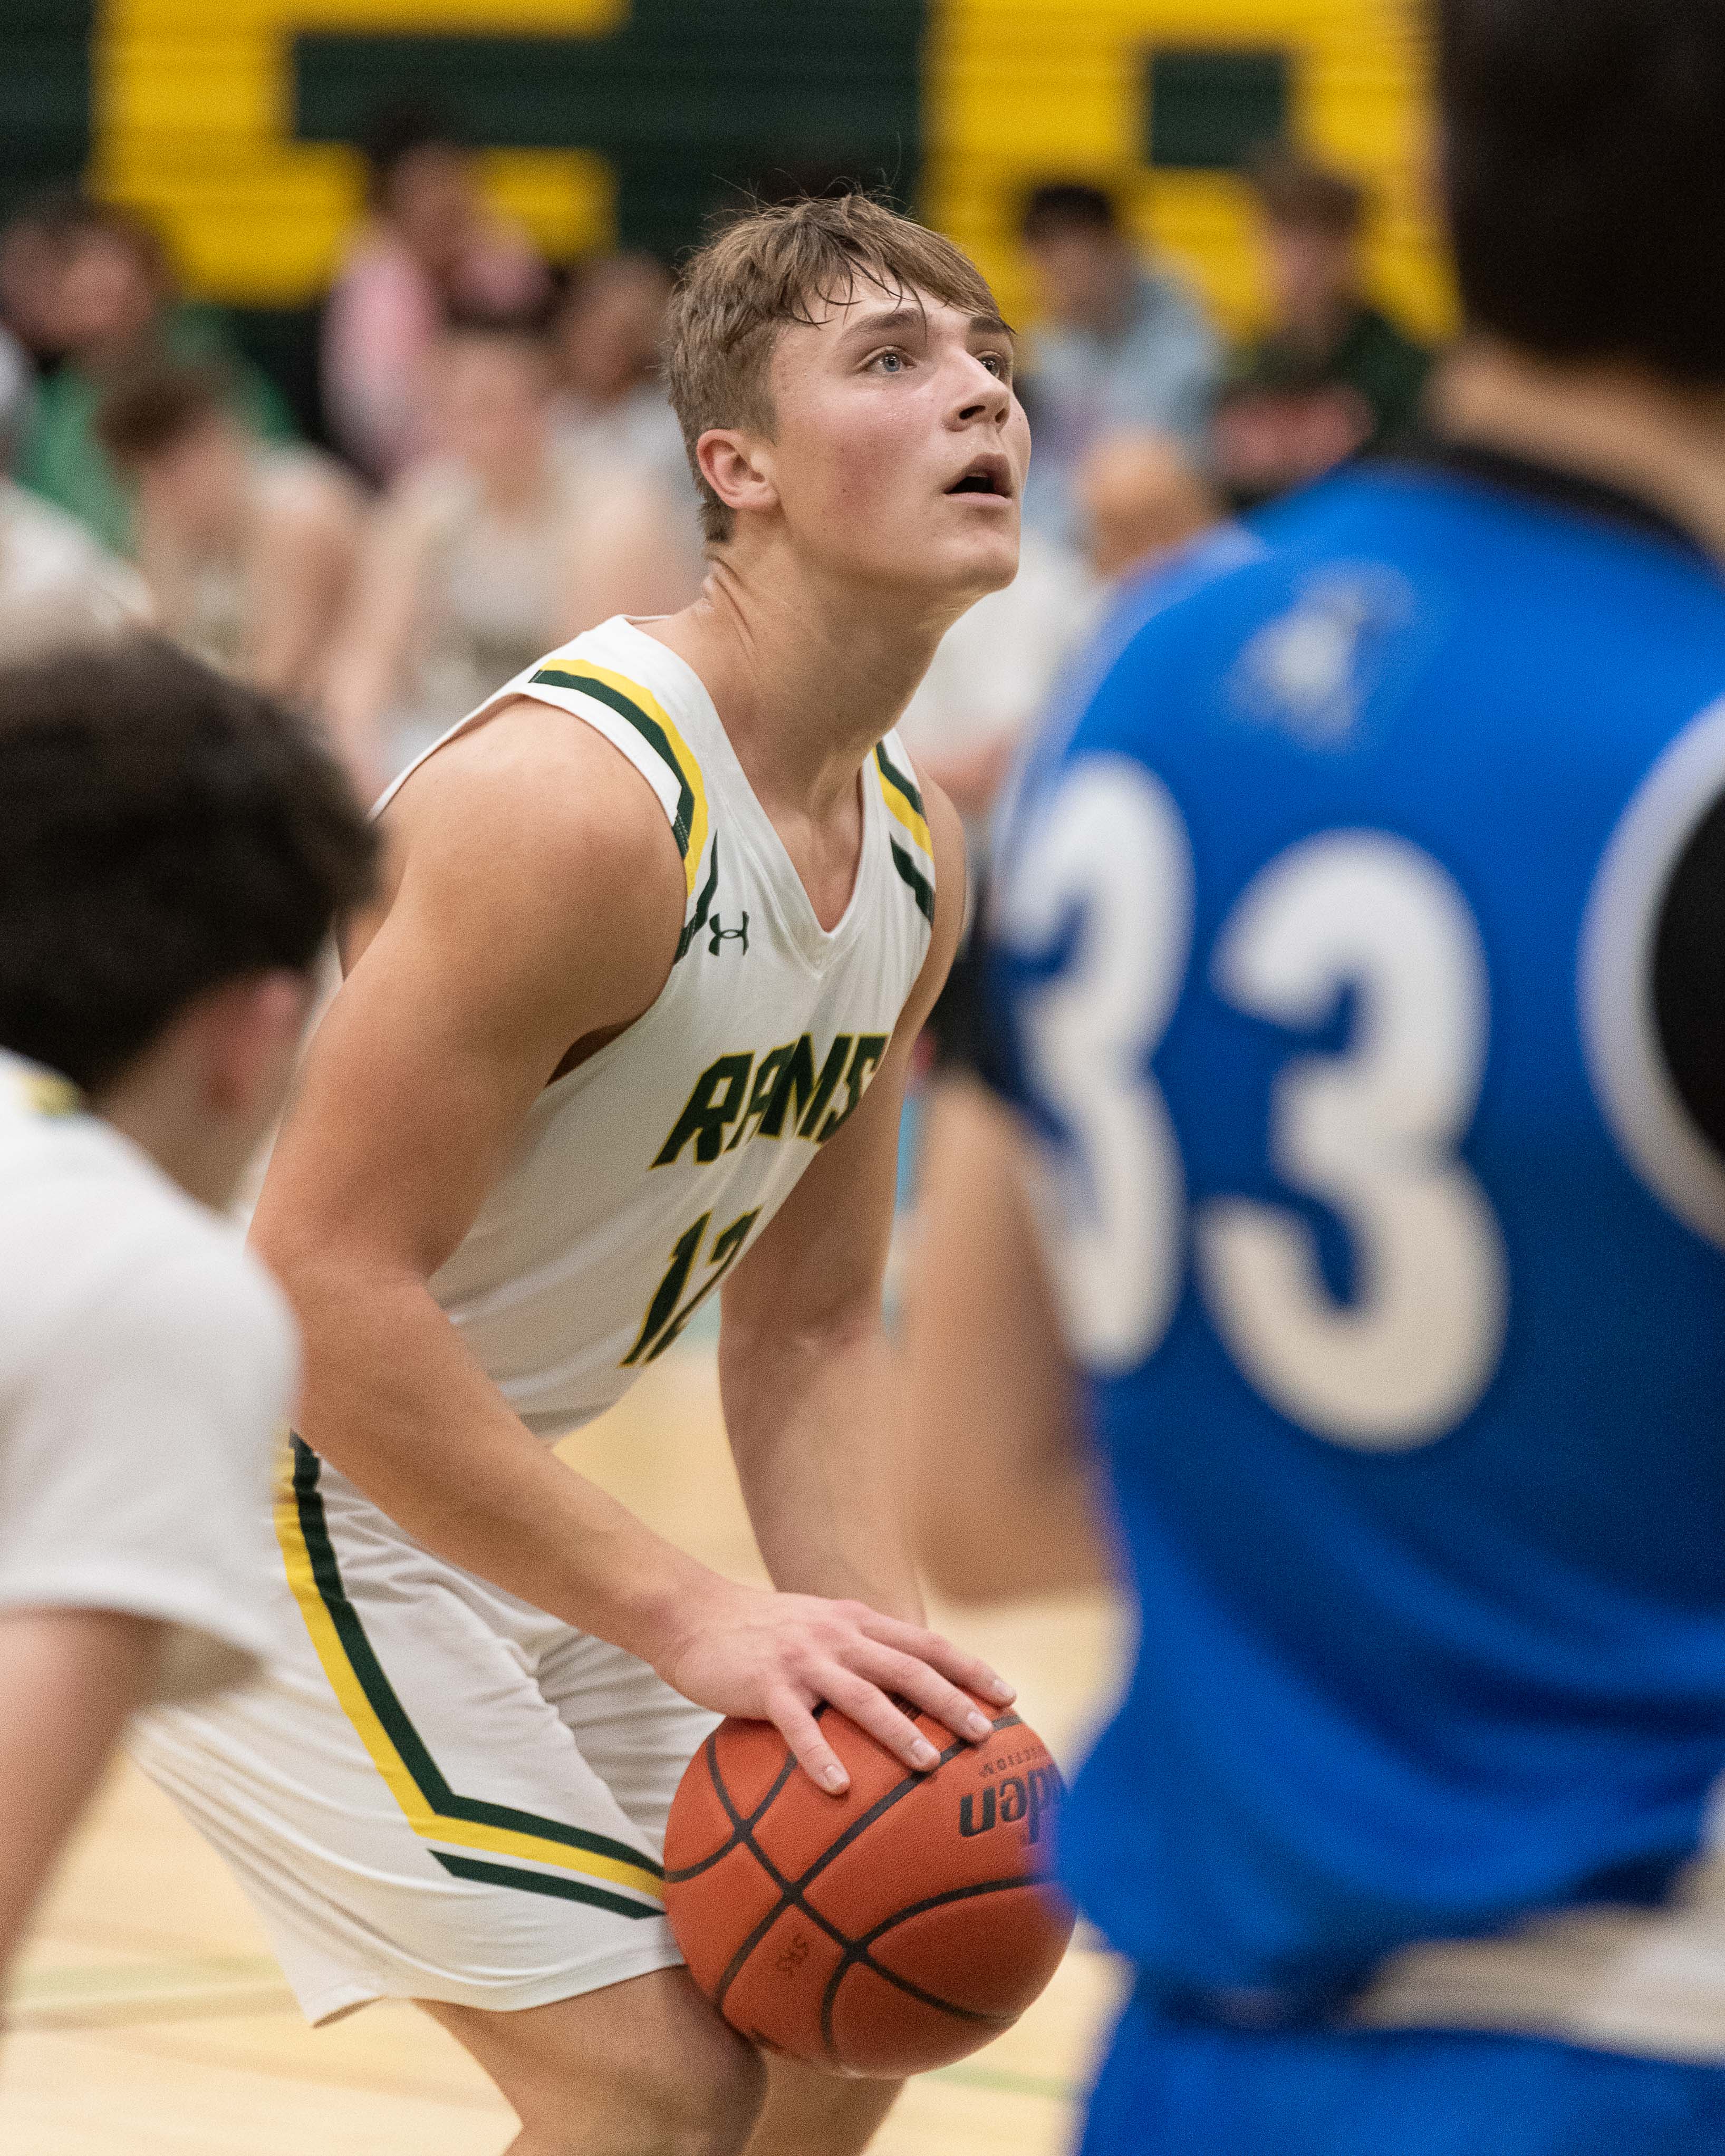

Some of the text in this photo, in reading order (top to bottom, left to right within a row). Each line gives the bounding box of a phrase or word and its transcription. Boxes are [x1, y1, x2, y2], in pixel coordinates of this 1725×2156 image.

[648, 1031, 893, 1172] RAMS
[1002, 750, 1511, 1454] 33
[959, 1764, 1059, 1843] den
